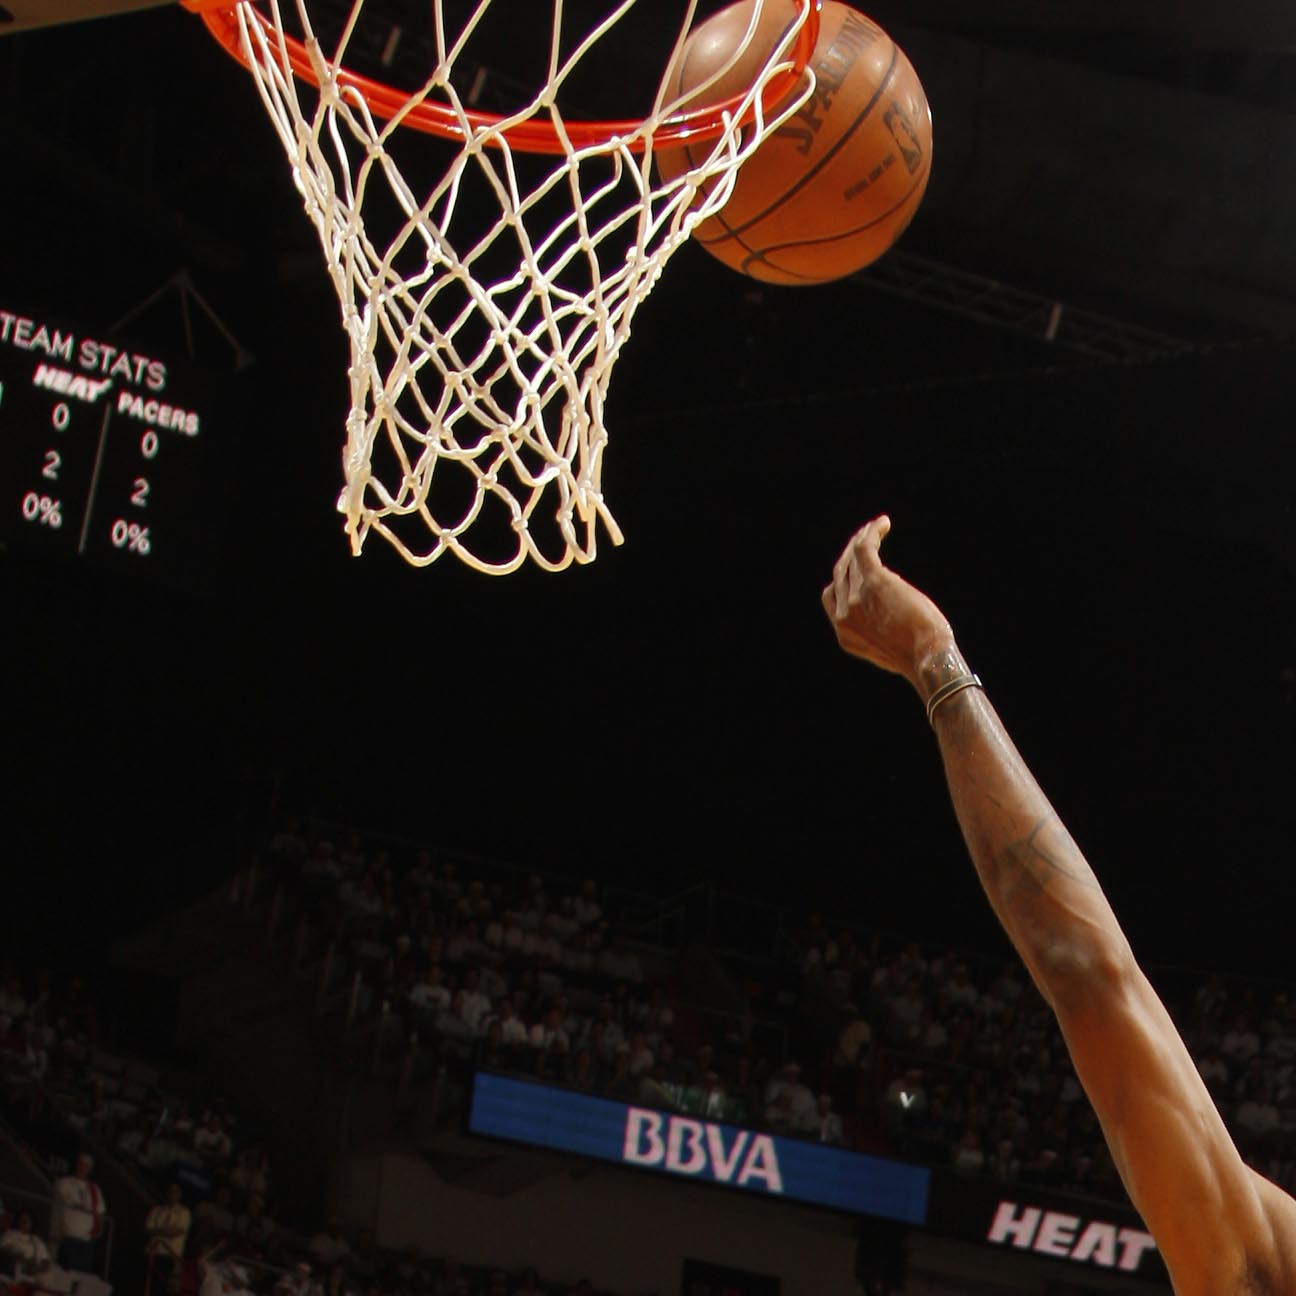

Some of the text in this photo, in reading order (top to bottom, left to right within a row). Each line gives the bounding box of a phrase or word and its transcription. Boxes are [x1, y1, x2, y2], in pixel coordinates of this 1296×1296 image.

[0, 310, 168, 392] TEAM STATS
[33, 363, 200, 438] HEAT PACERS
[51, 400, 160, 461] 0 0
[42, 449, 151, 508] 2 2
[22, 490, 152, 556] 0% 0%
[622, 1106, 783, 1194] BBVA
[986, 1200, 1160, 1273] HEAT
